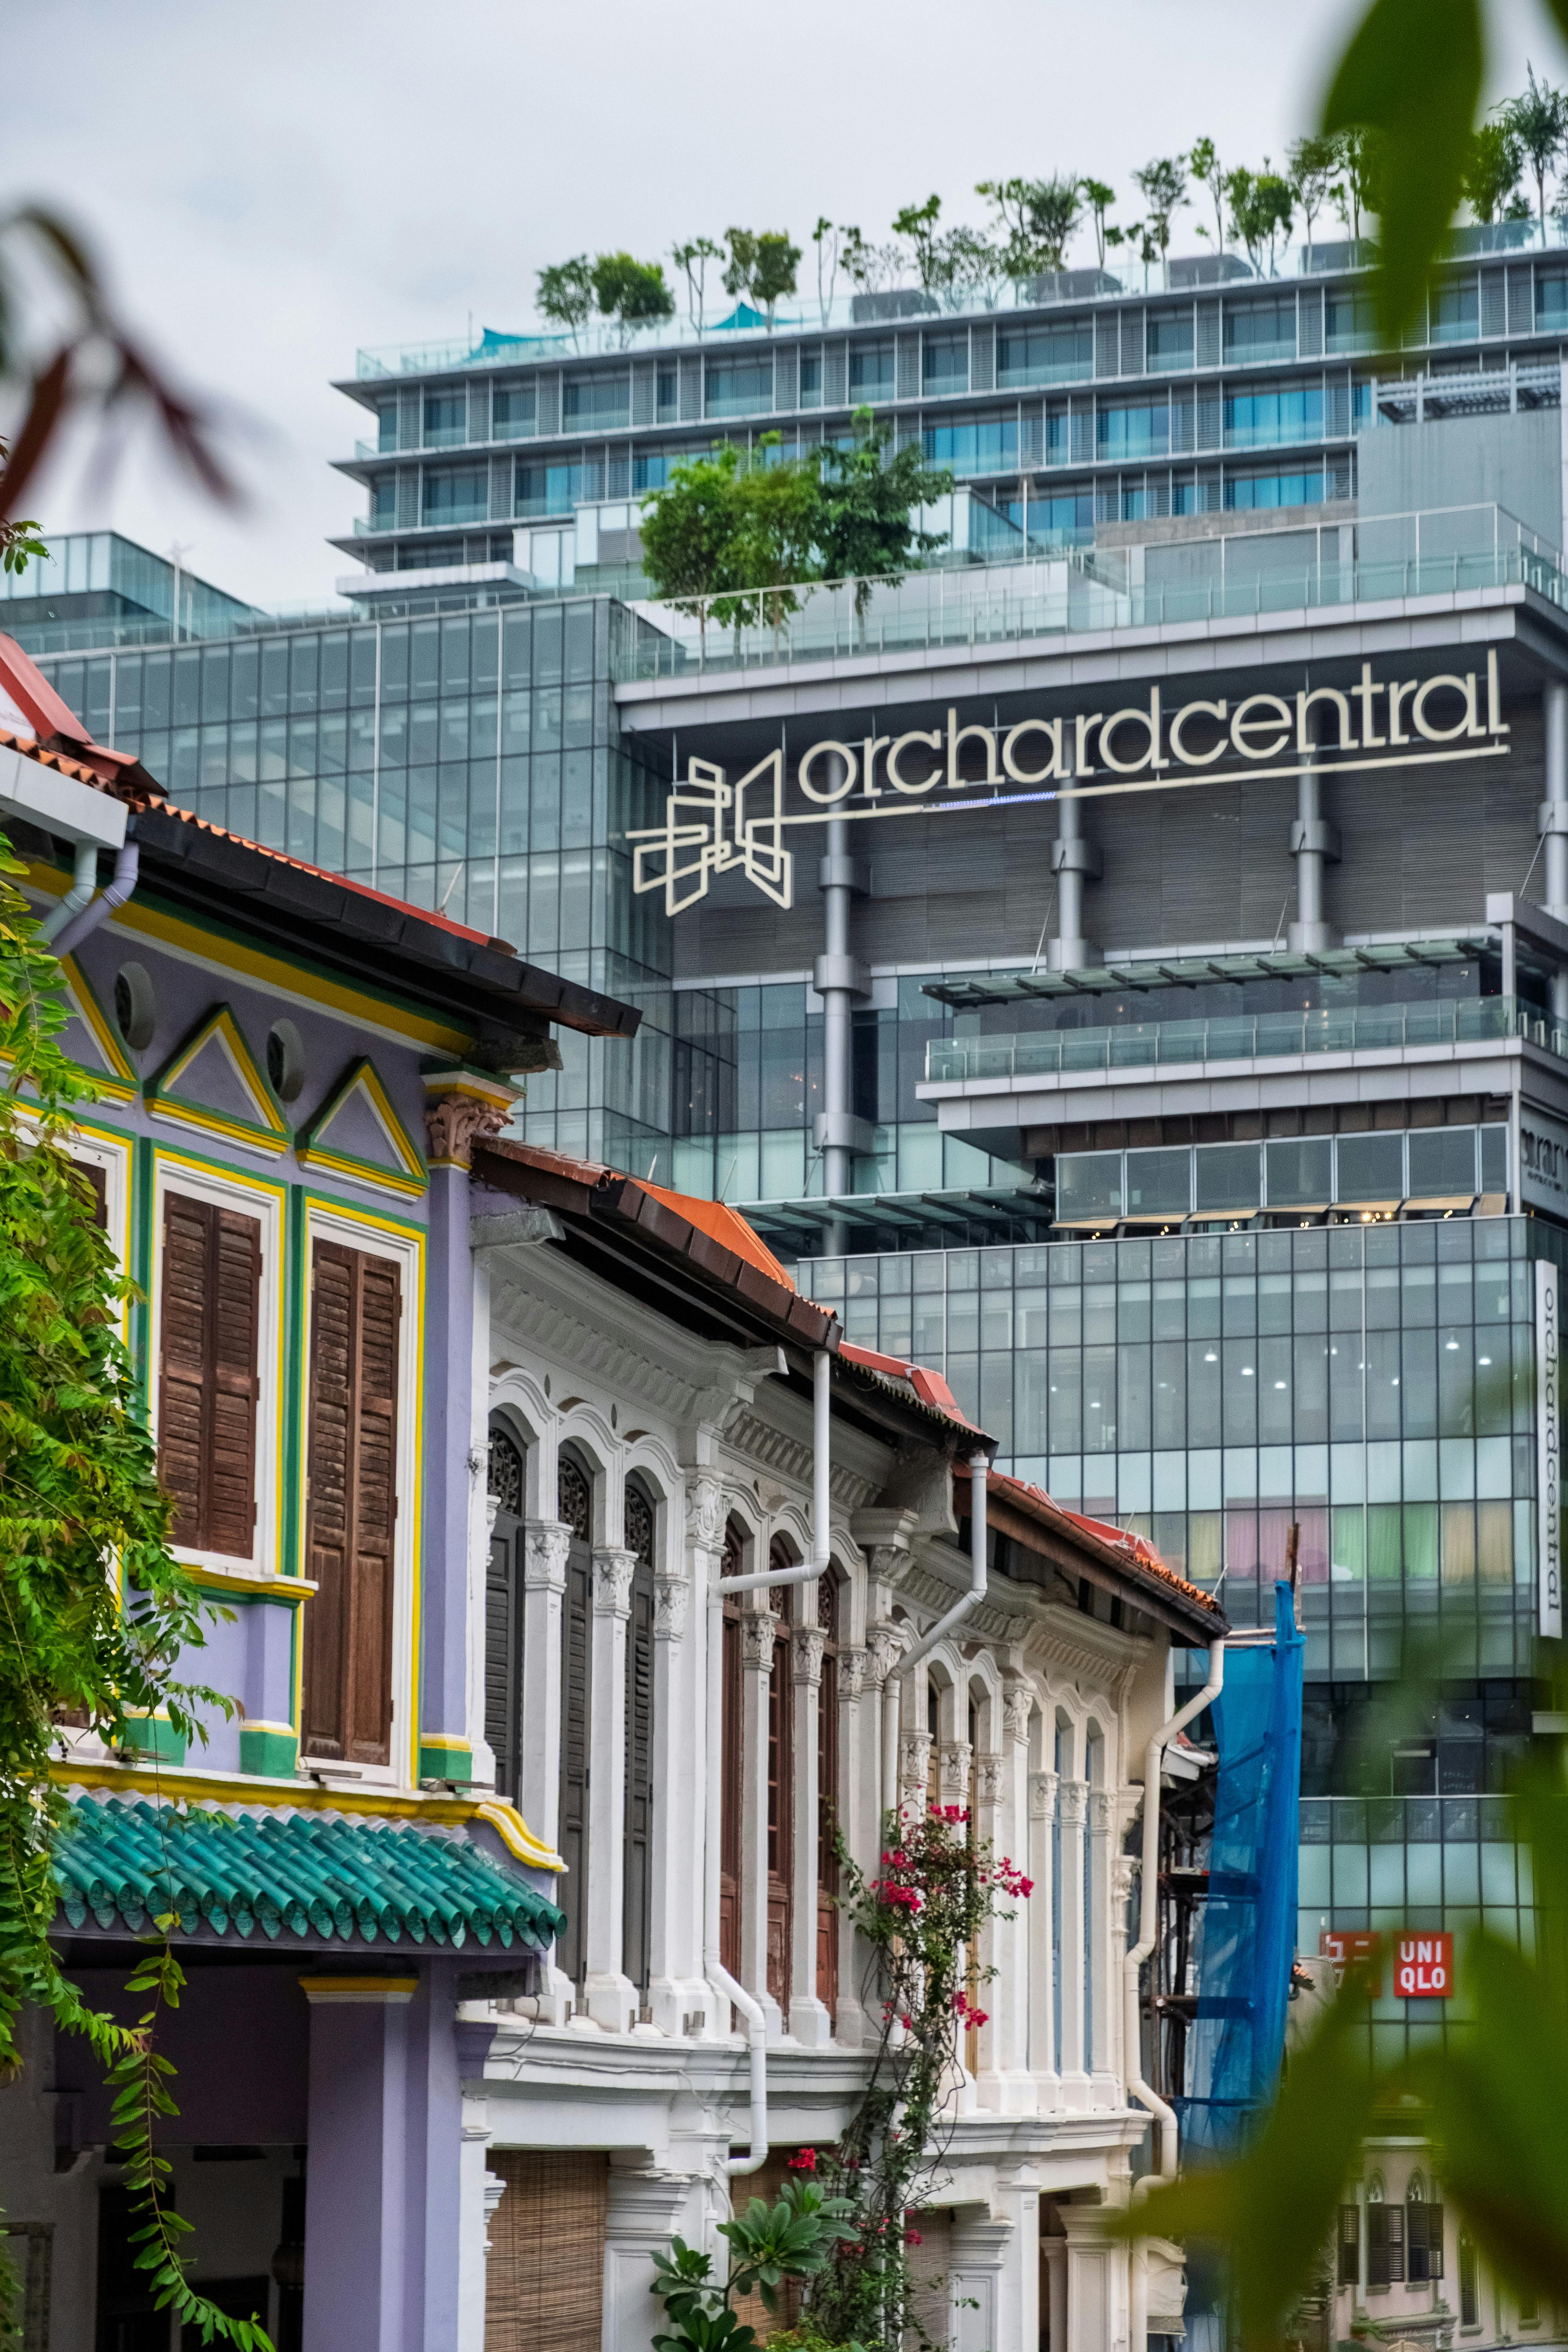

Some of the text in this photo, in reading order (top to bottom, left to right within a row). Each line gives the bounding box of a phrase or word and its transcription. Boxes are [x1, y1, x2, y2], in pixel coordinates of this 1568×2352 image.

[798, 649, 1510, 803] orchardcentral
[1544, 1287, 1559, 1610] orchardcentral
[1401, 1941, 1442, 1963] UNI
[1401, 1967, 1445, 1993] QLO
